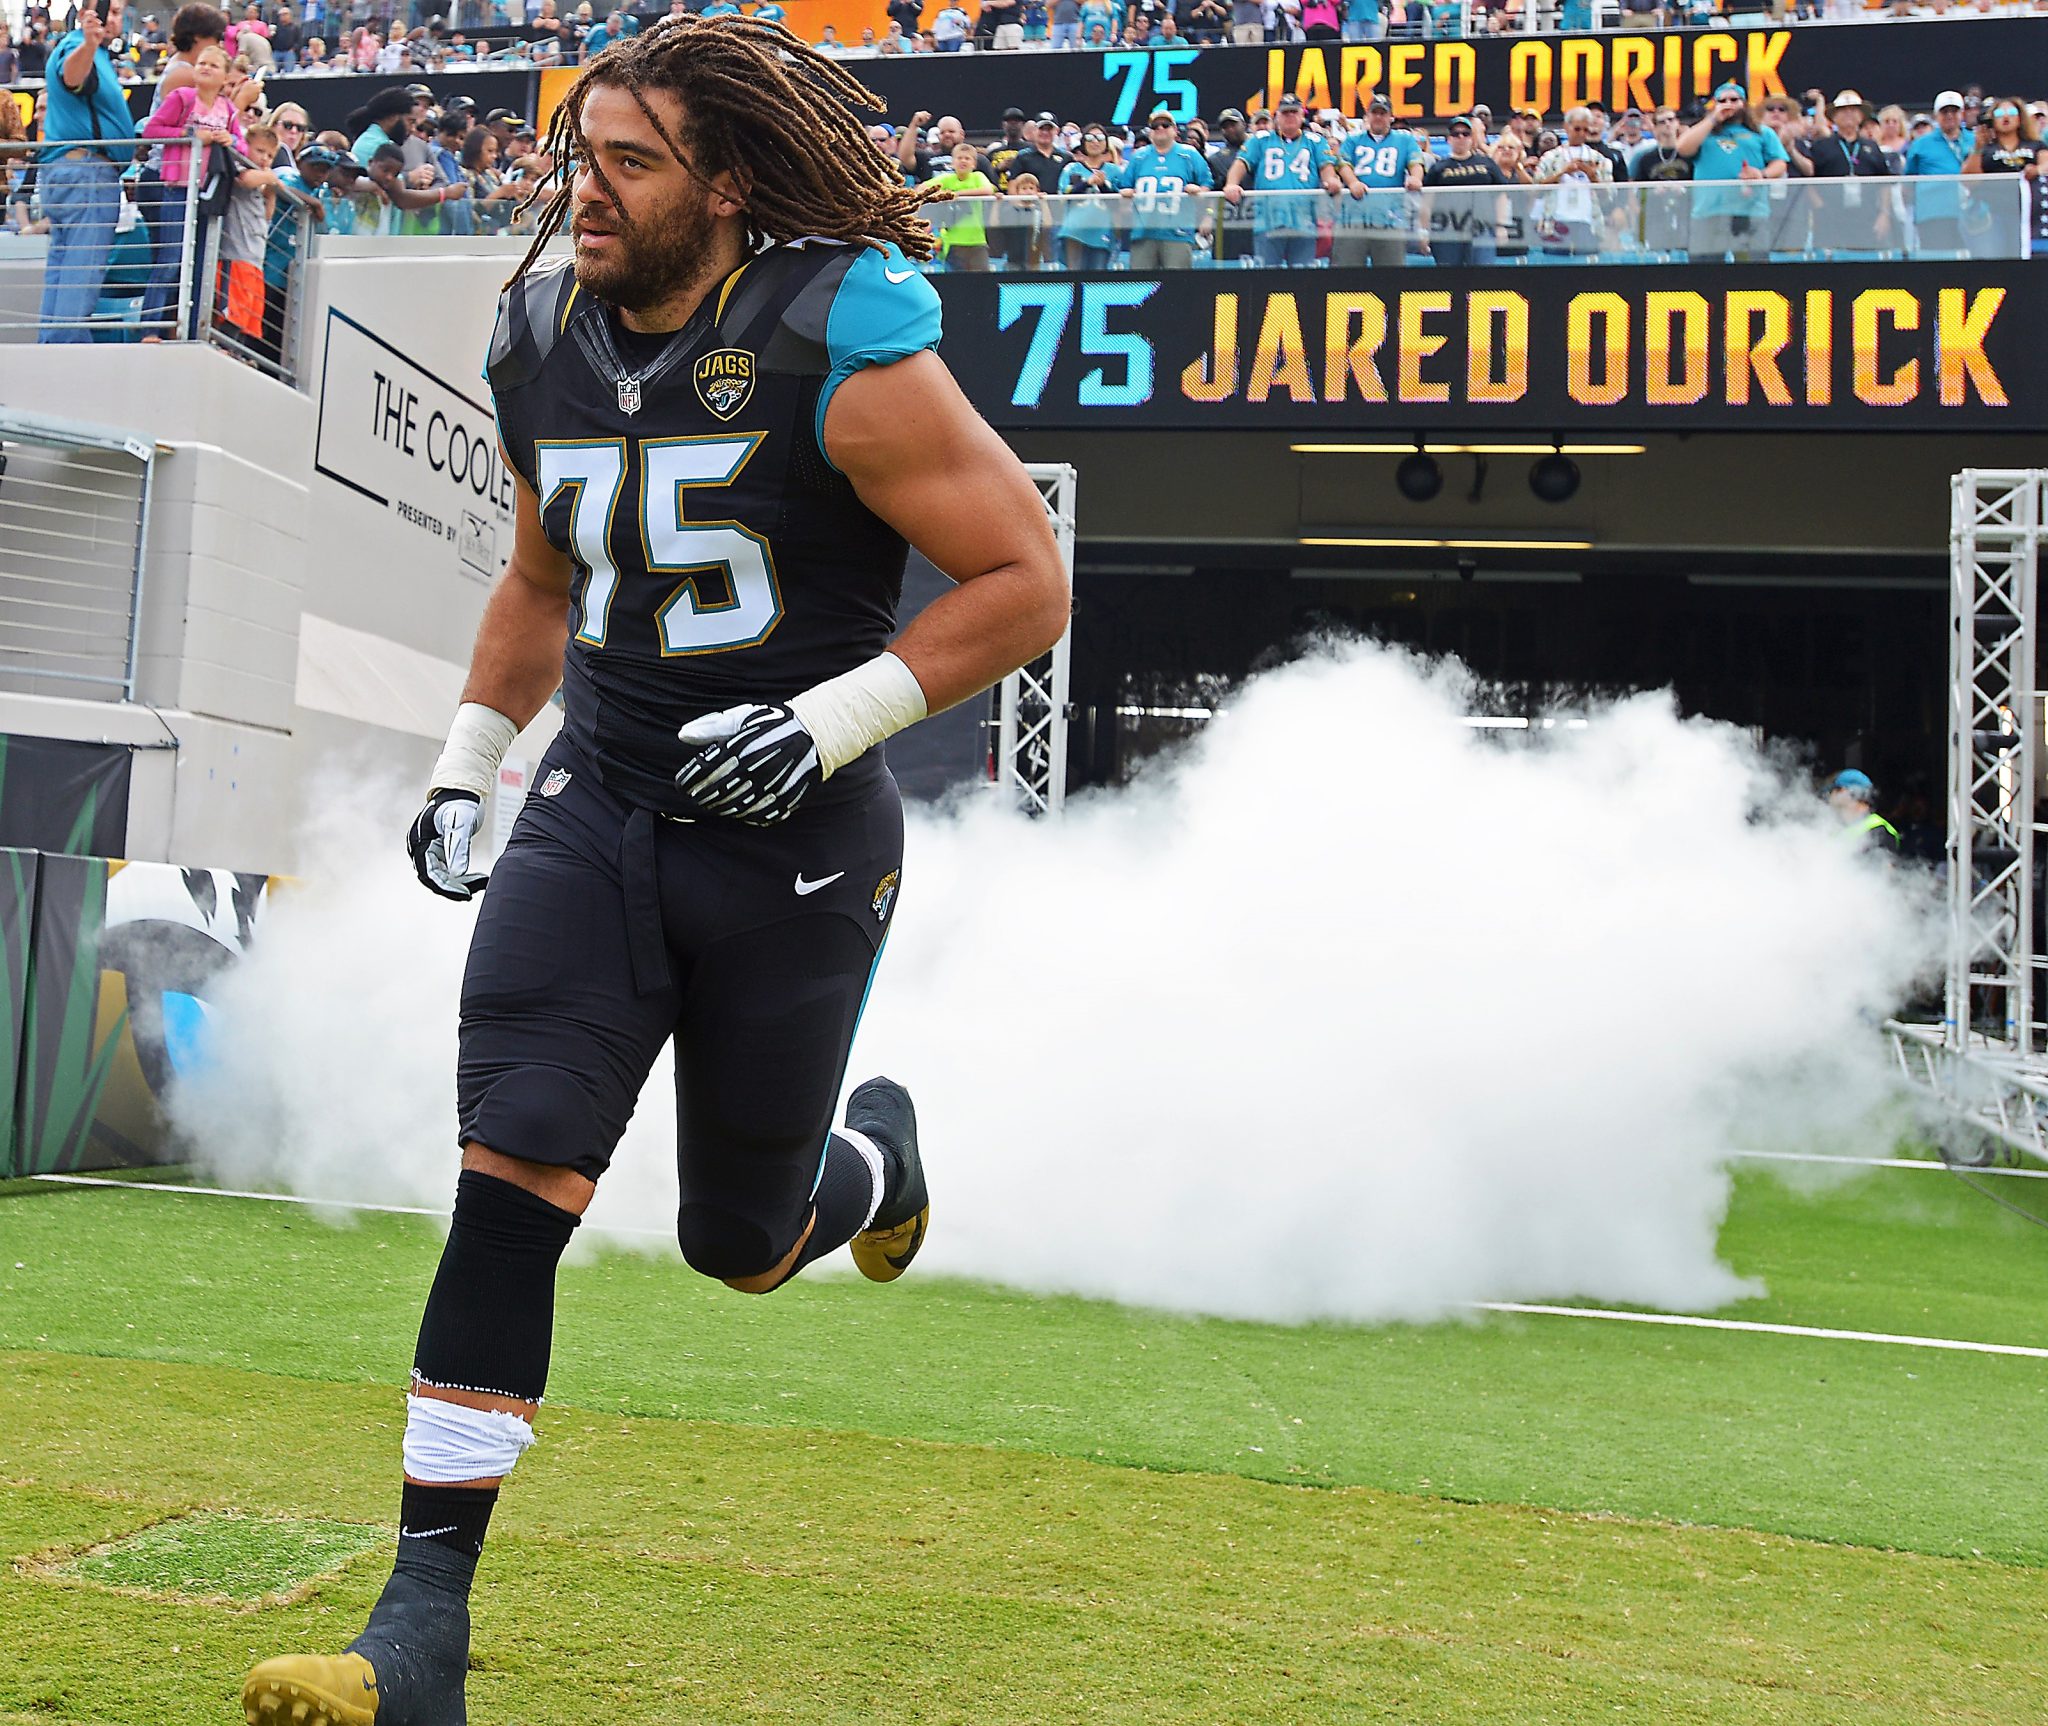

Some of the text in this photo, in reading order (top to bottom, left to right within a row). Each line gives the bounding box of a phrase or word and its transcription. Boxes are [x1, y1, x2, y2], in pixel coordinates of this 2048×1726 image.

[1104, 31, 1792, 125] 75 JARED ODRICK
[1264, 147, 1312, 182] 64
[1355, 146, 1398, 178] 28
[998, 281, 2009, 408] 75 JARED ODRICK
[699, 355, 751, 380] JAGS
[374, 370, 418, 457] THE
[620, 393, 638, 409] NFL
[397, 500, 457, 542] PRESENTED BY
[534, 430, 786, 658] 75
